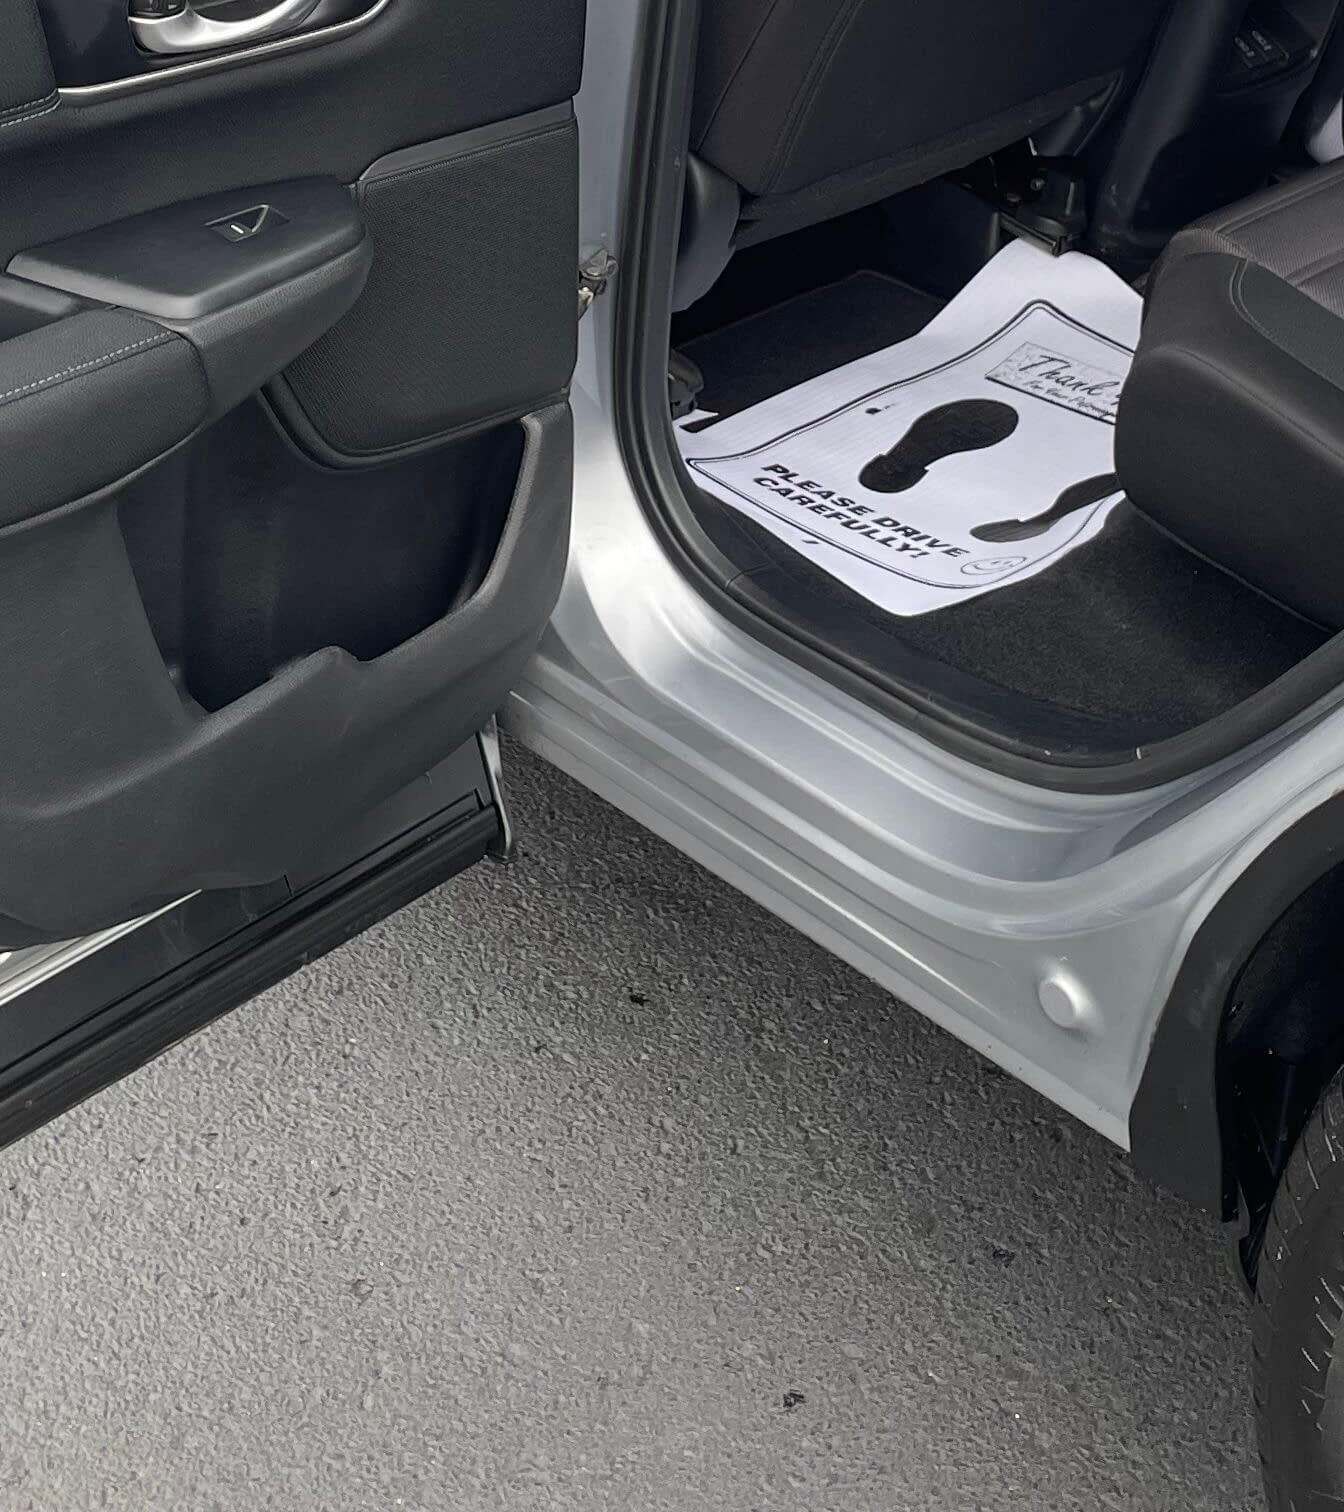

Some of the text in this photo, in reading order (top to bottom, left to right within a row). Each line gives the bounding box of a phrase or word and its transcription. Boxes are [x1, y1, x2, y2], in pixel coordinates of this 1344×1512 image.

[1018, 354, 1120, 396] Thank
[752, 476, 930, 559] CAREFULLY!
[760, 463, 972, 558] PLEASE DRIVE
